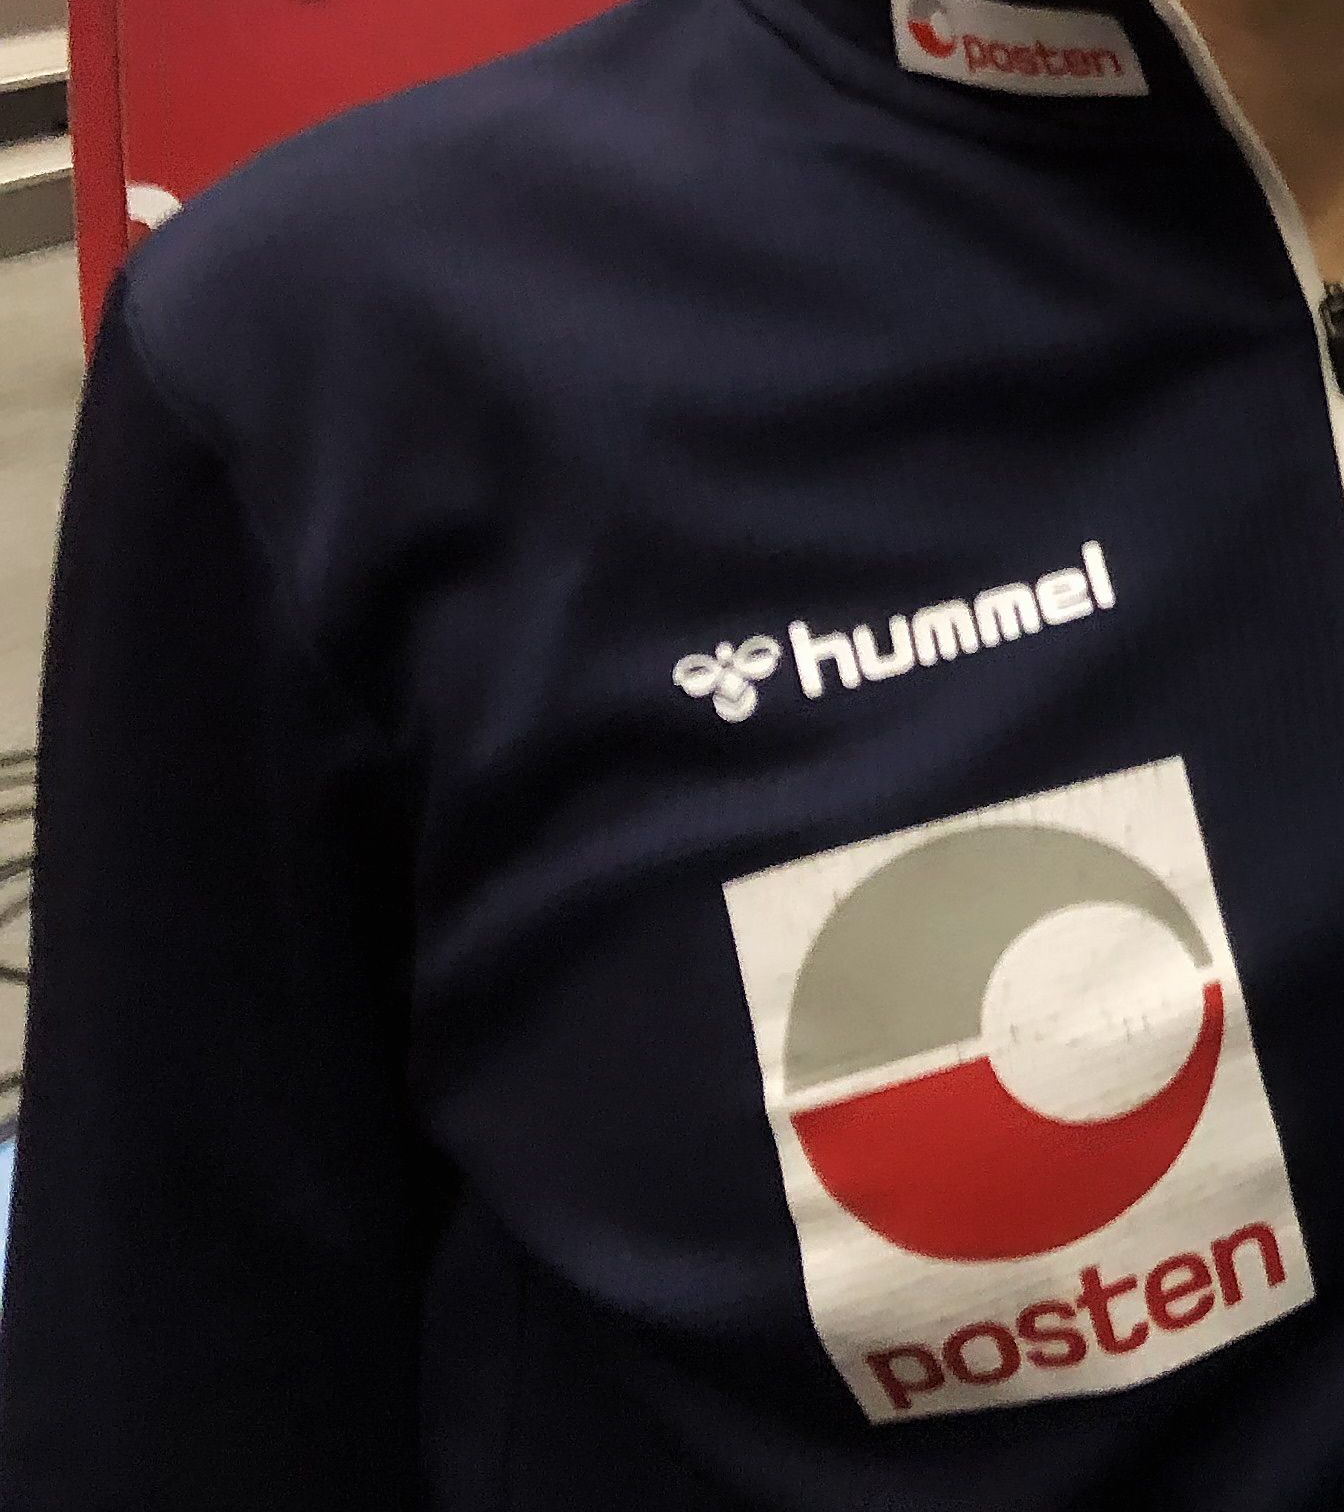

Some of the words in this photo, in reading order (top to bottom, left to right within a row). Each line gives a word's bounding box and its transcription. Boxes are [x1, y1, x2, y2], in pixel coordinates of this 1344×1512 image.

[963, 35, 1123, 77] posten
[788, 539, 1116, 700] hummel
[865, 1220, 1287, 1411] posten
